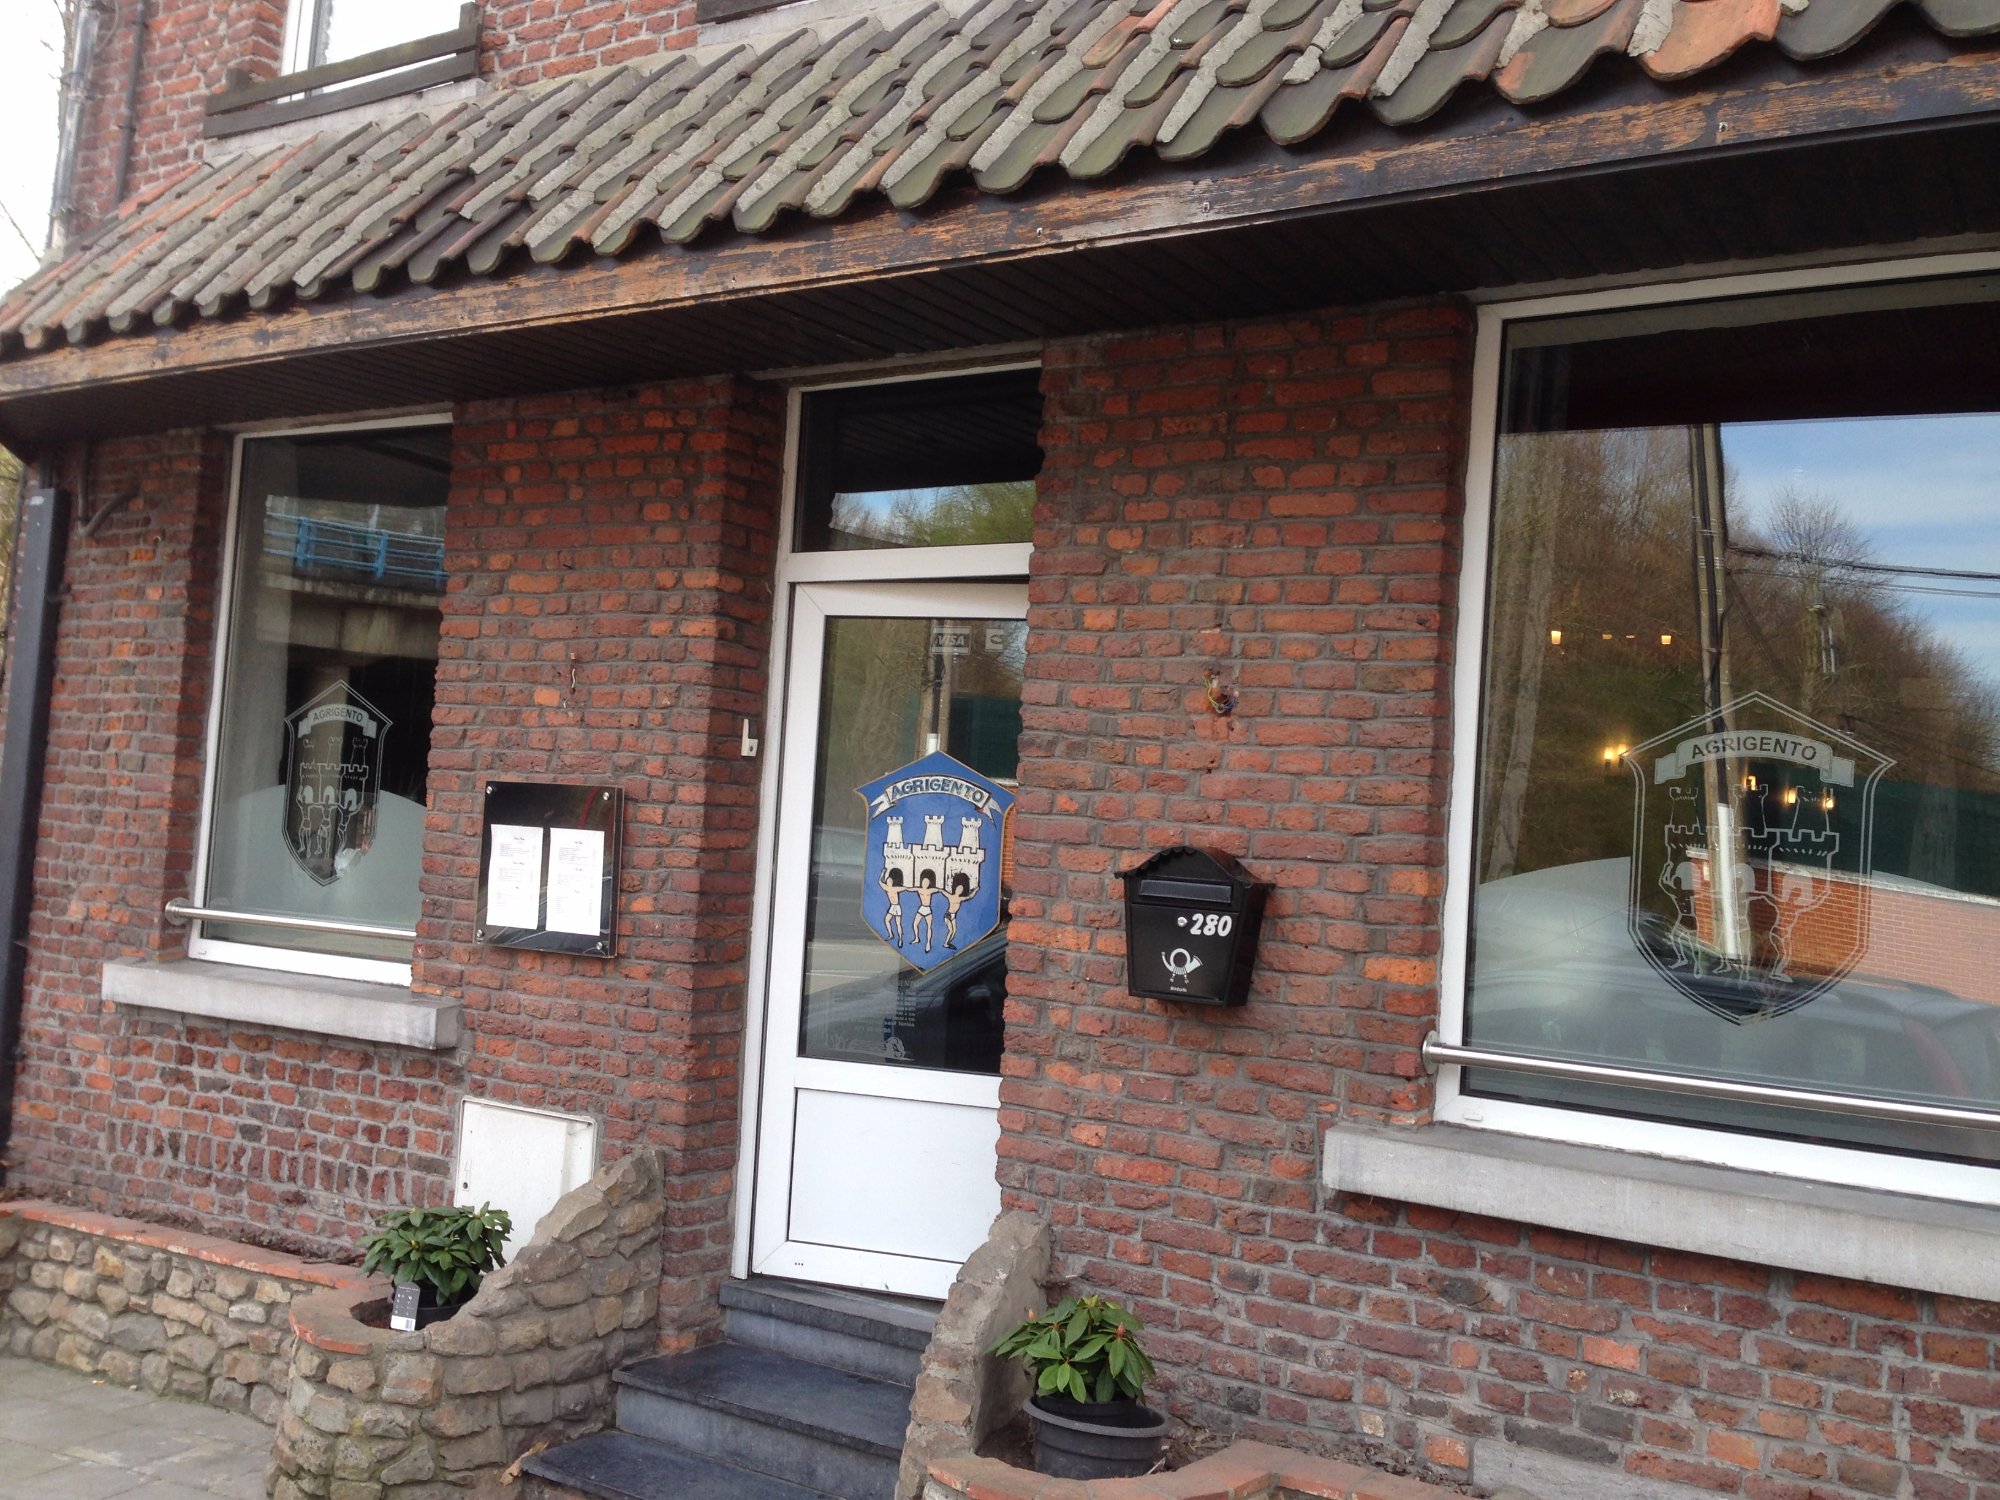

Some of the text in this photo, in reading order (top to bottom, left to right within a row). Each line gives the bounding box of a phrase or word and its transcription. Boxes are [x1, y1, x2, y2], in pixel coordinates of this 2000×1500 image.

[937, 635, 966, 646] VISA
[313, 706, 364, 723] AGRIGENTO
[1691, 735, 1818, 761] AGRIGENTO
[890, 777, 985, 802] AGRIGENTO
[1189, 913, 1233, 937] 280
